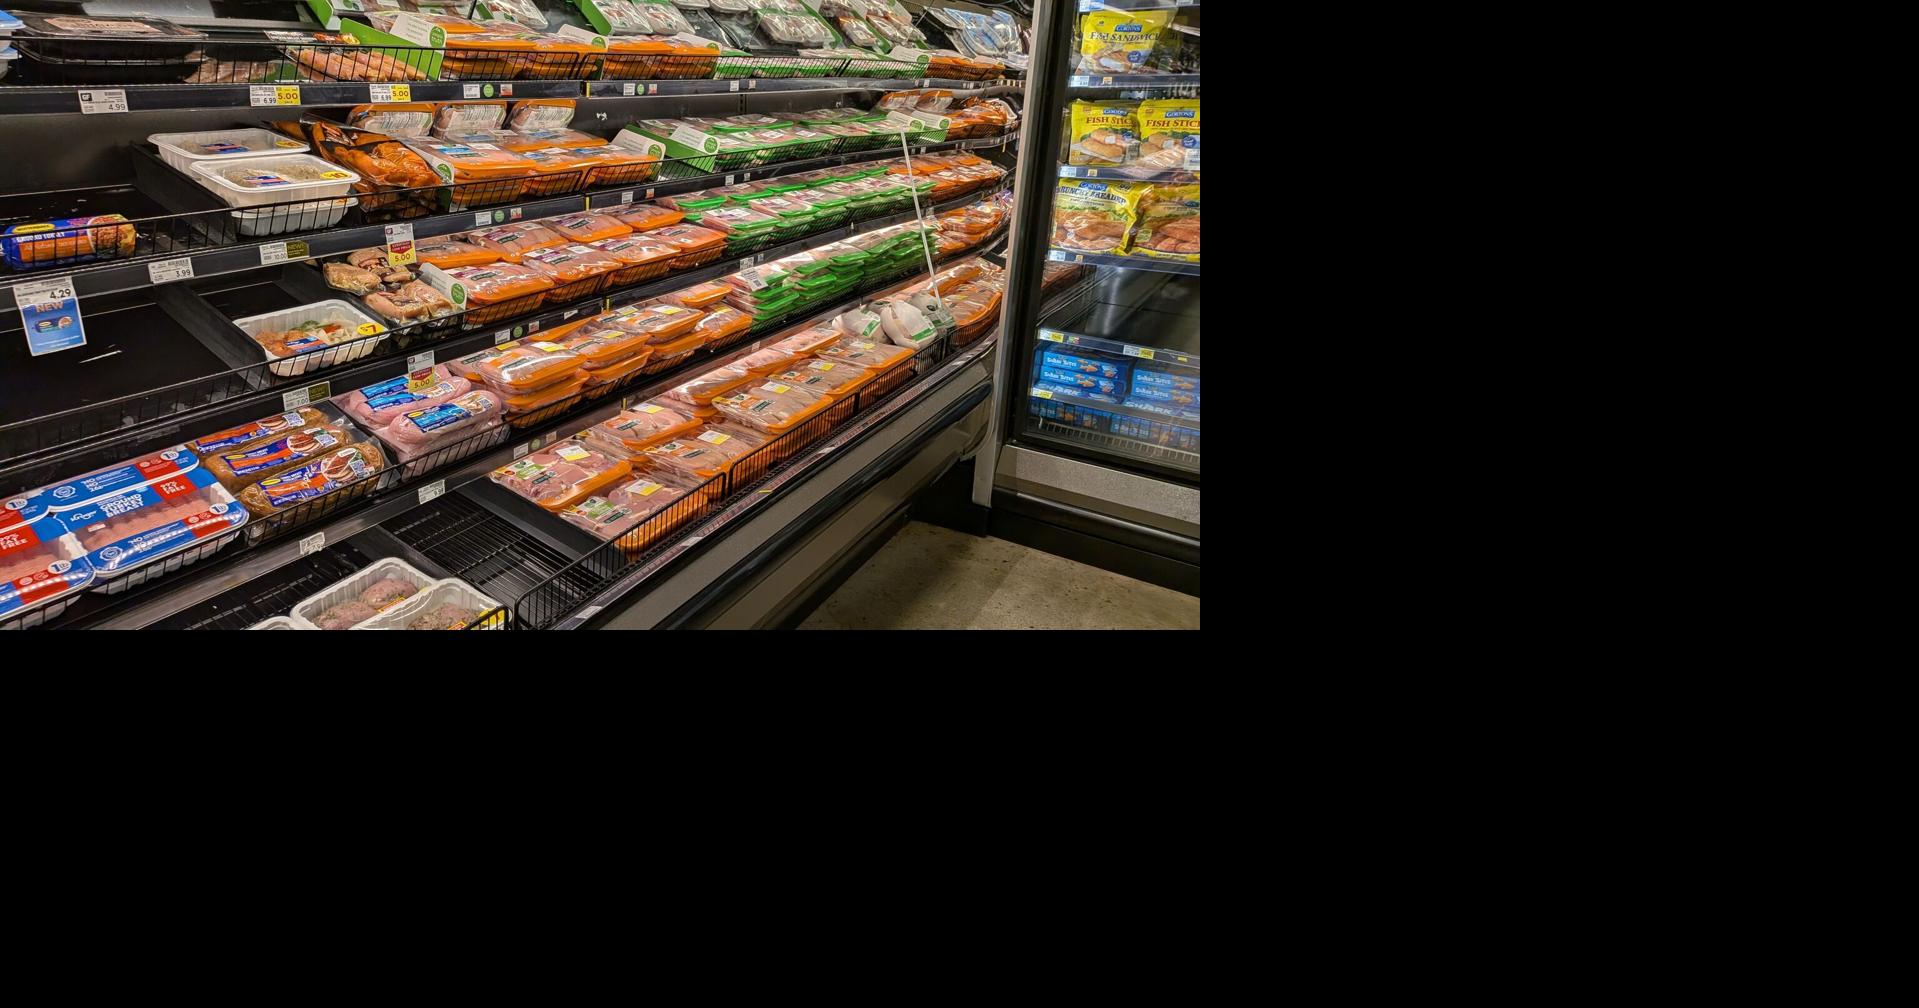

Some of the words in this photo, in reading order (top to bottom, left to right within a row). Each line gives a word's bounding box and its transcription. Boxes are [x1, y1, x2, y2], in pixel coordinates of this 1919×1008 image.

[277, 92, 299, 100] 5.00
[108, 103, 126, 111] 4.99
[1086, 116, 1109, 124] FISH
[394, 253, 411, 262] 5.00
[175, 269, 191, 278] 3.99
[49, 288, 71, 300] 4.29
[35, 301, 64, 313] NEW
[414, 379, 430, 389] 5.00
[165, 485, 186, 495] FREE
[100, 494, 142, 510] GROUND
[102, 497, 143, 514] TURKEY
[106, 501, 144, 518] BREAST
